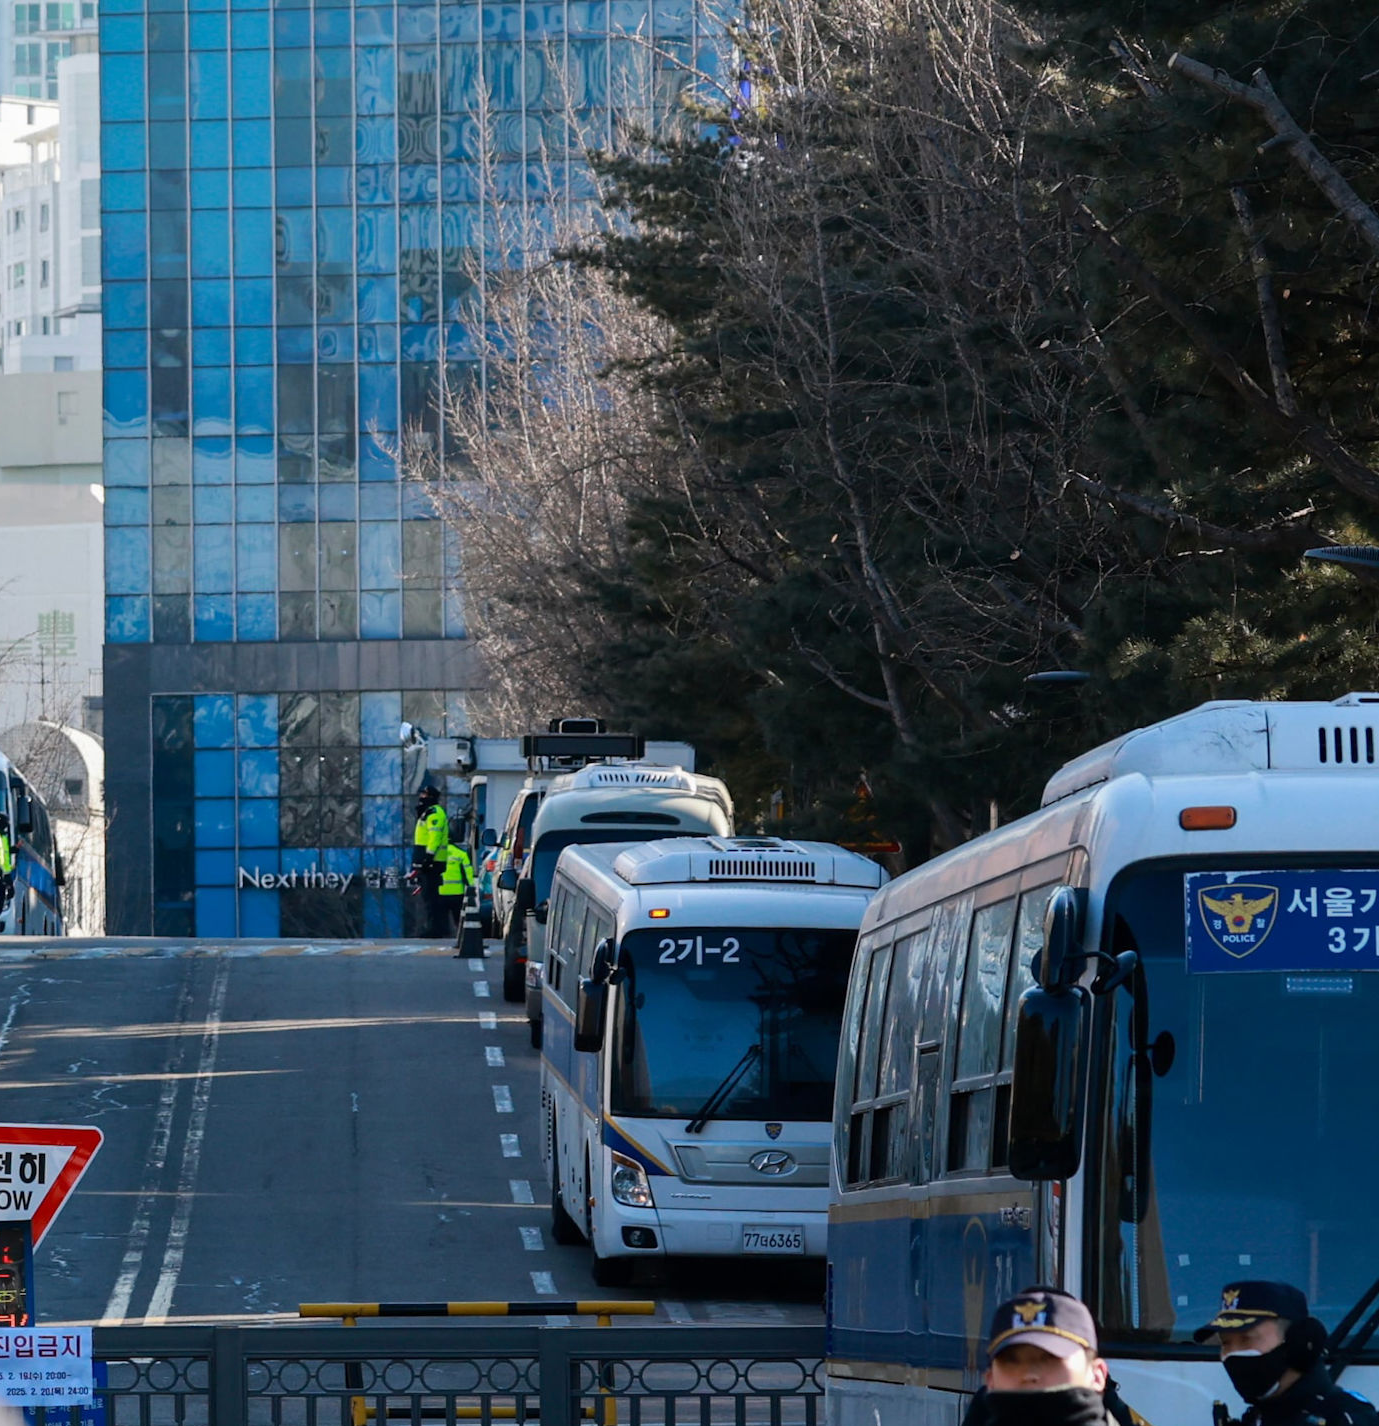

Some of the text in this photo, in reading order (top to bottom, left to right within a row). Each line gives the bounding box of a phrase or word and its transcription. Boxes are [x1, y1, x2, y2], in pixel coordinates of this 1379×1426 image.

[238, 866, 298, 889] Next
[1223, 934, 1256, 943] POLICE
[659, 936, 740, 965] 2기-2
